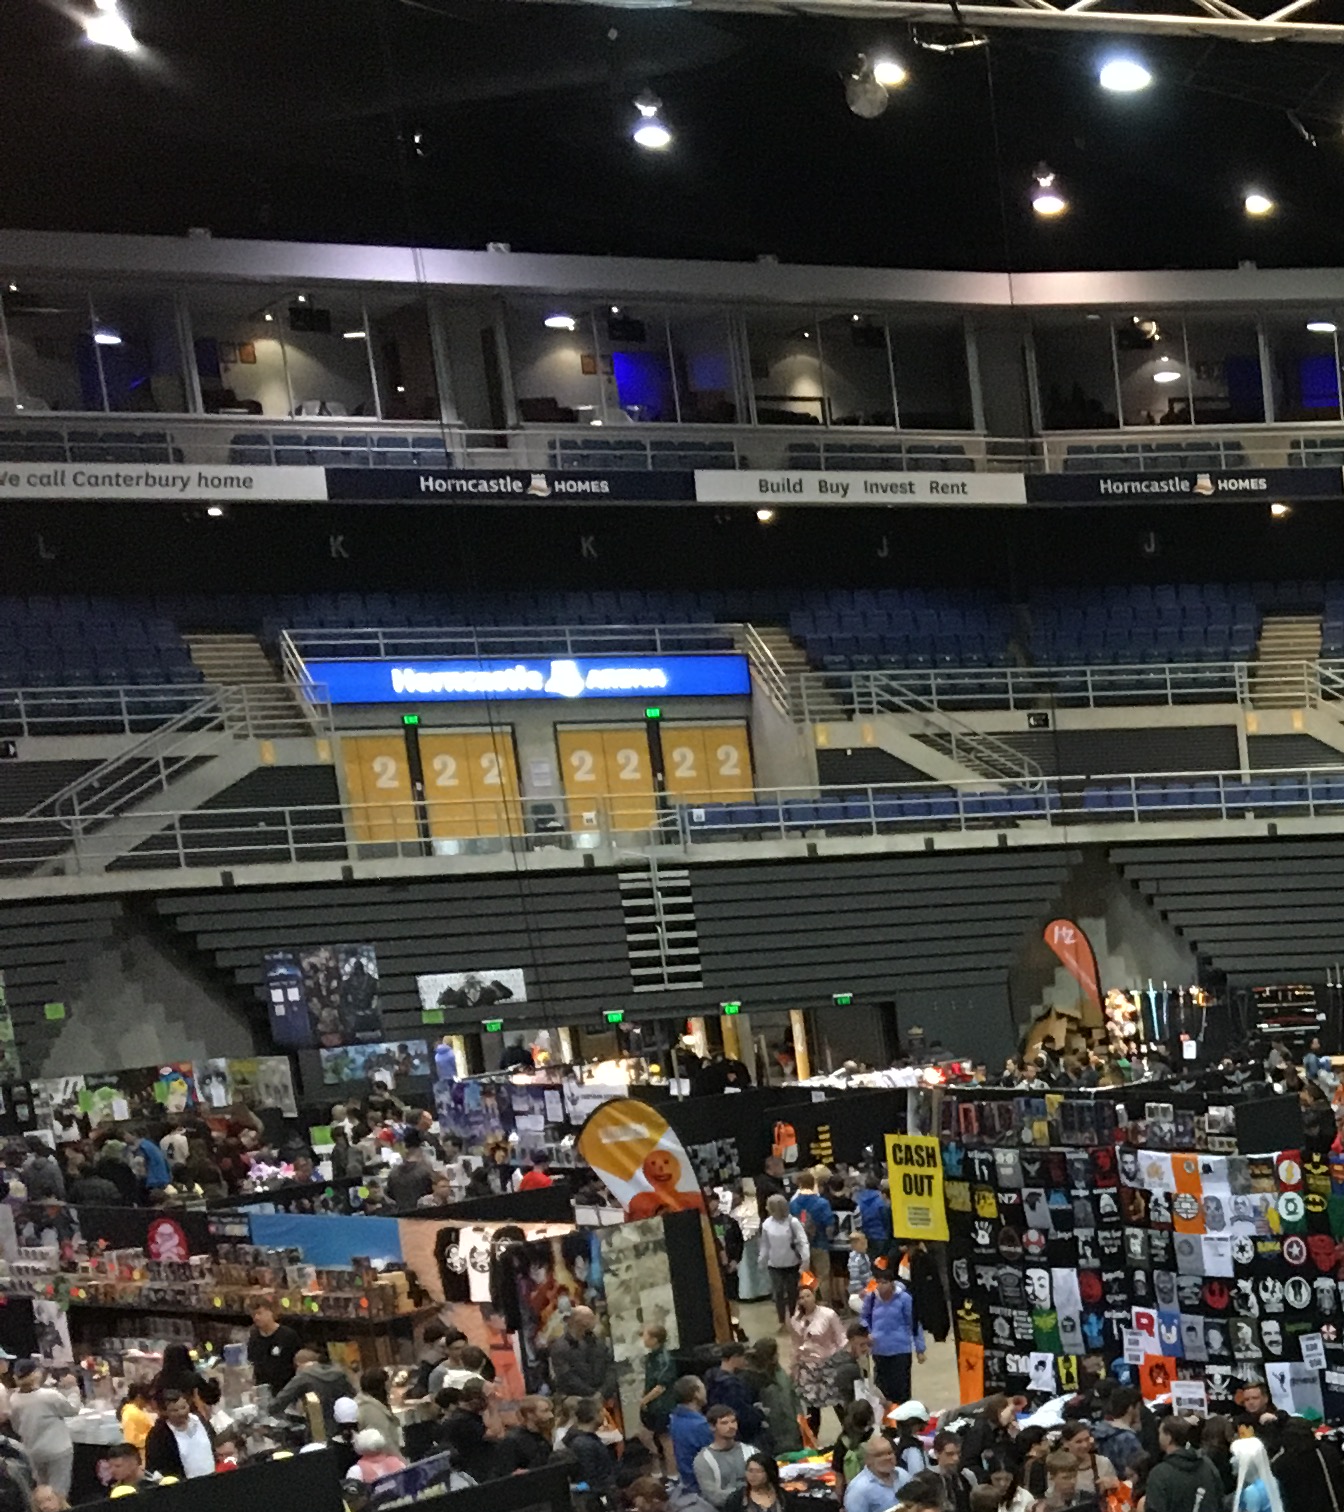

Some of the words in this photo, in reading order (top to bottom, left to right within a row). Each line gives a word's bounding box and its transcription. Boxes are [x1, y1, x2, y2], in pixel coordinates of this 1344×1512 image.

[26, 469, 66, 488] call
[72, 470, 191, 492] Canterbury
[197, 471, 254, 489] home
[419, 474, 523, 494] Horncastle
[554, 480, 609, 494] HOMES
[759, 478, 804, 494] Build
[818, 478, 850, 498] Buy
[864, 479, 916, 496] Invest
[930, 479, 968, 496] Rent
[1100, 476, 1190, 494] Horncastle
[1218, 478, 1267, 491] HOMES
[329, 535, 349, 558] K
[581, 535, 598, 558] K
[877, 535, 889, 558] J
[1144, 532, 1156, 553] J
[372, 756, 399, 788] 2
[433, 755, 458, 787] 2
[571, 750, 595, 781] 2
[617, 748, 641, 780] 2
[672, 746, 697, 778] 2
[717, 745, 741, 776] 2
[892, 1143, 937, 1168] CASH
[902, 1173, 934, 1197] OUT
